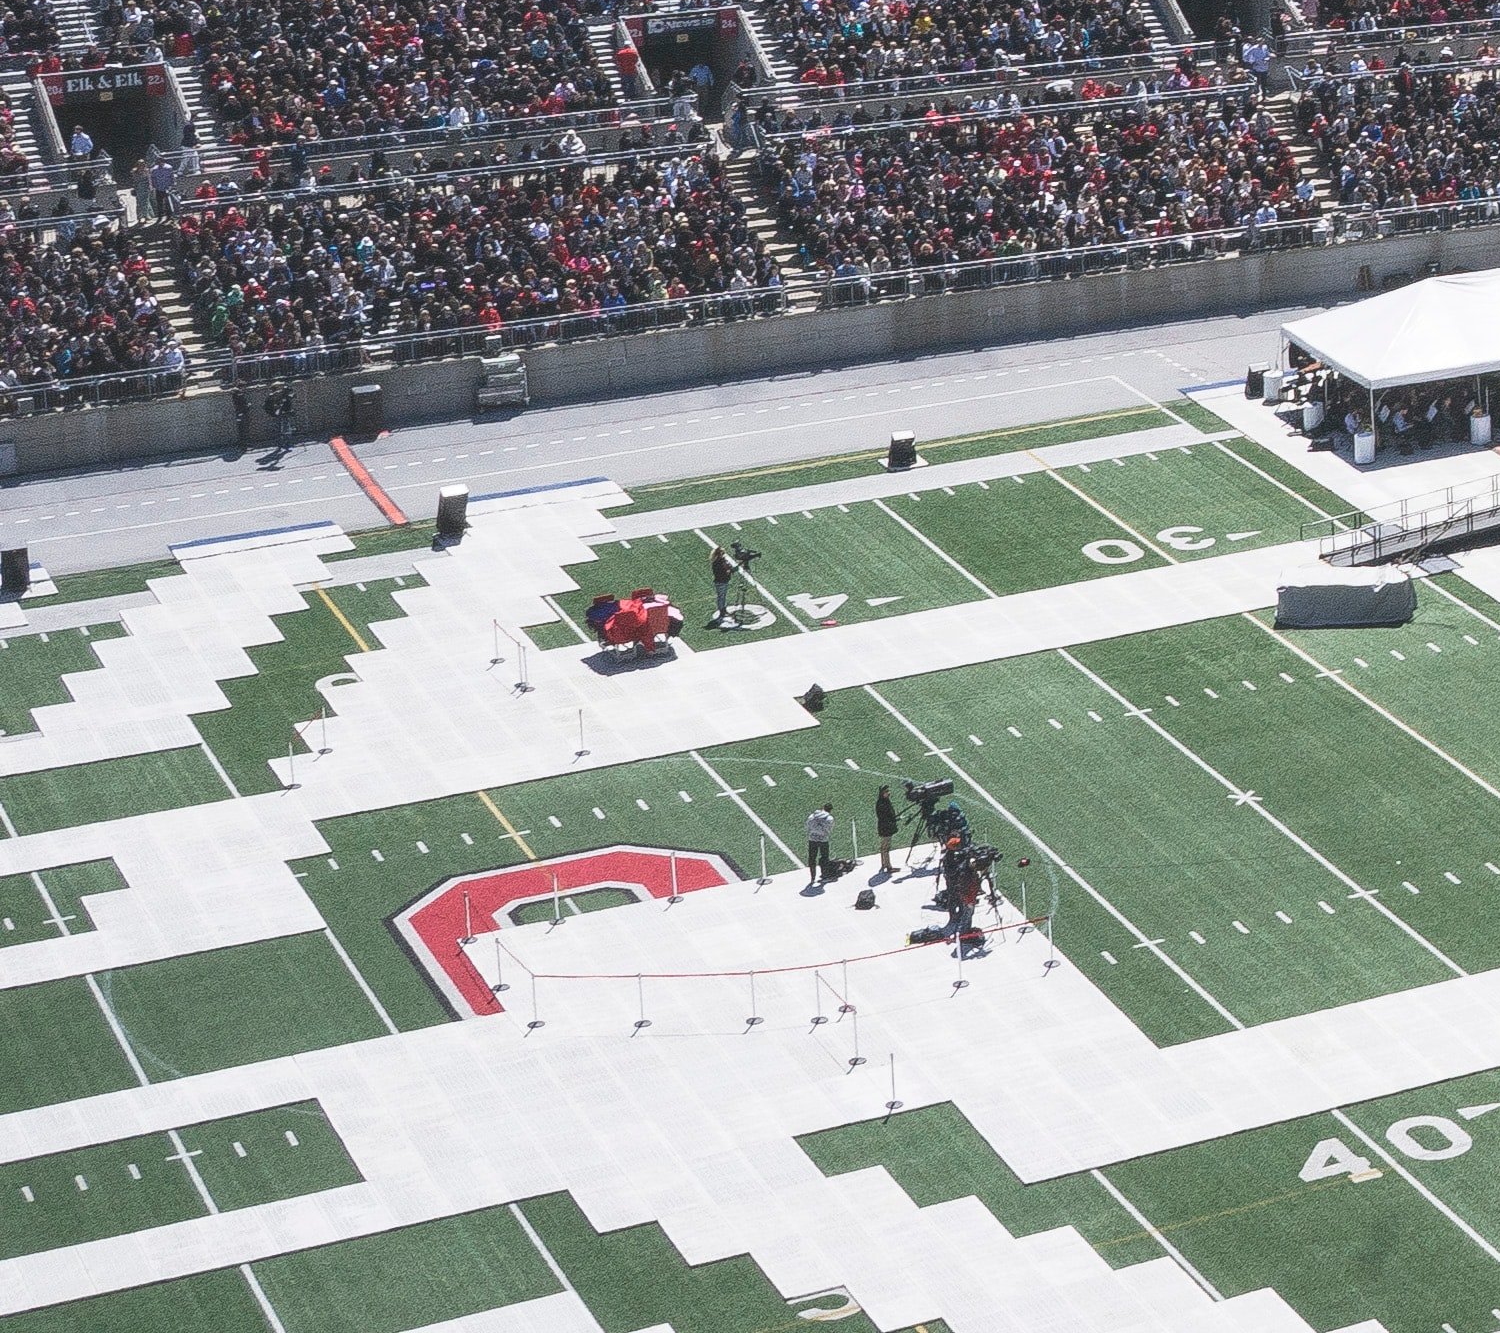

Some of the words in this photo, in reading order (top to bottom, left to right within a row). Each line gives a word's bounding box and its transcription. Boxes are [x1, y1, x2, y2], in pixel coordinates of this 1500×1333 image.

[66, 77, 94, 93] Elk
[99, 75, 112, 90] &
[114, 72, 143, 88] Elk
[1300, 1114, 1475, 1185] 40
